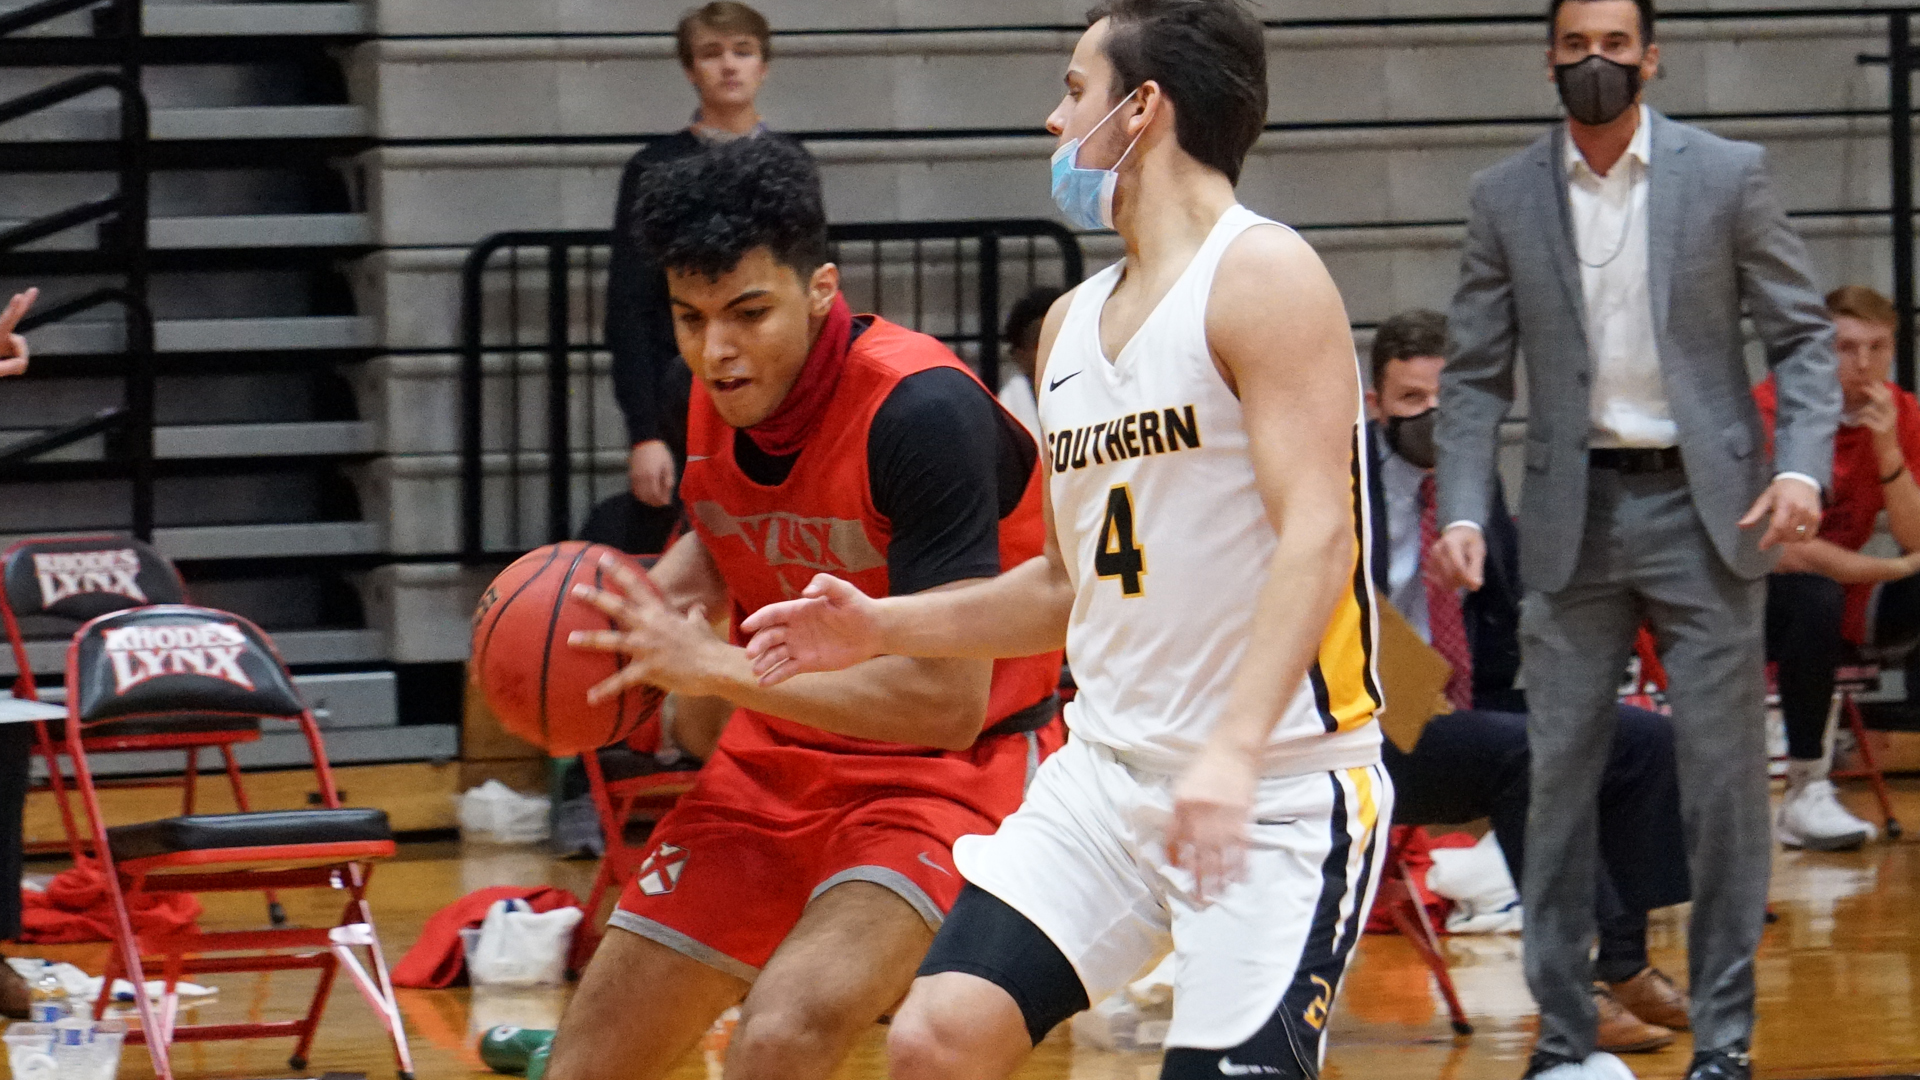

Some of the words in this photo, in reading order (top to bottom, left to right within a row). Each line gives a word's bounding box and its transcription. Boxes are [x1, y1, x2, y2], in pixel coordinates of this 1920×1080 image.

[1095, 482, 1148, 599] 4
[36, 569, 148, 609] LYNX
[102, 622, 247, 652] RHODES
[107, 645, 255, 696] LYNX
